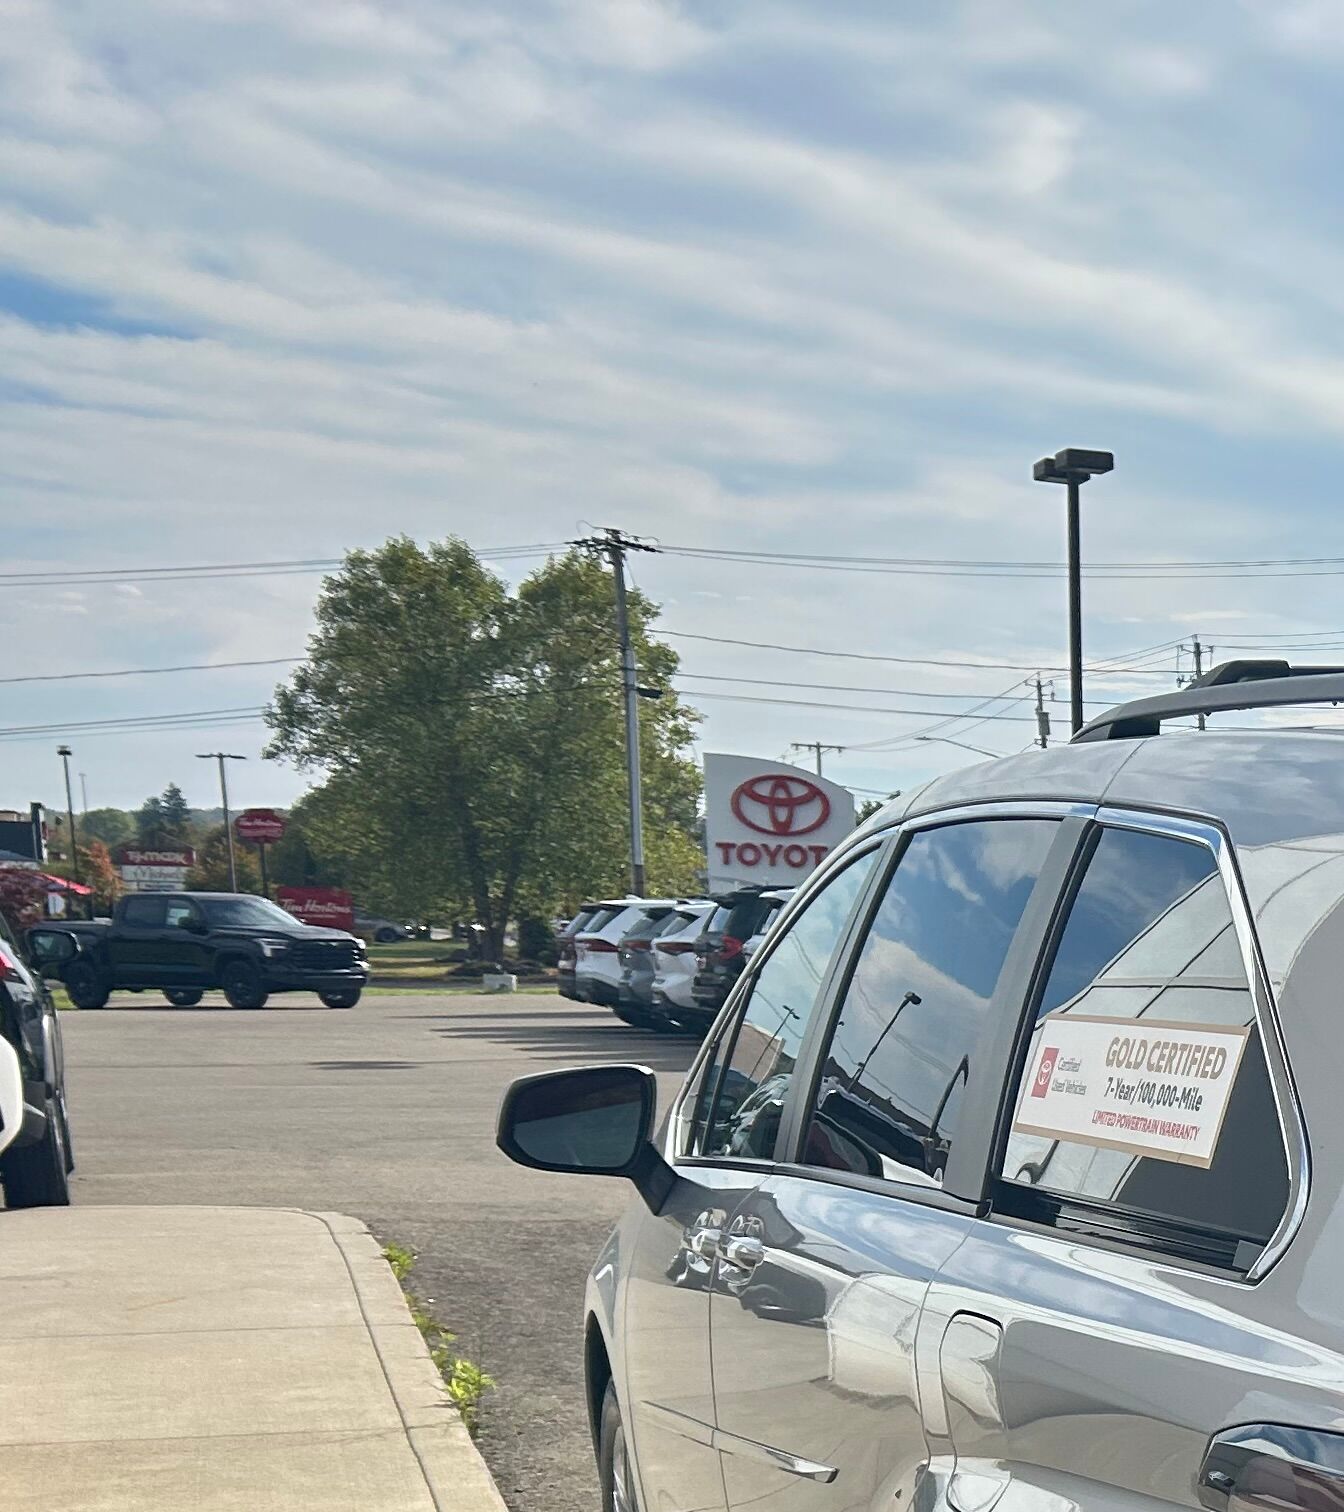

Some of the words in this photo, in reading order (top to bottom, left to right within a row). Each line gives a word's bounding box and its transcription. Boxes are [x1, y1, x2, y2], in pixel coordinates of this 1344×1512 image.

[715, 842, 829, 869] TOYOT
[1105, 1036, 1148, 1071] GOLD
[1146, 1040, 1228, 1081] CERTIFIED
[1103, 1076, 1203, 1112] 7-Year/100,000-Mile
[1158, 1119, 1202, 1141] WARRANTY
